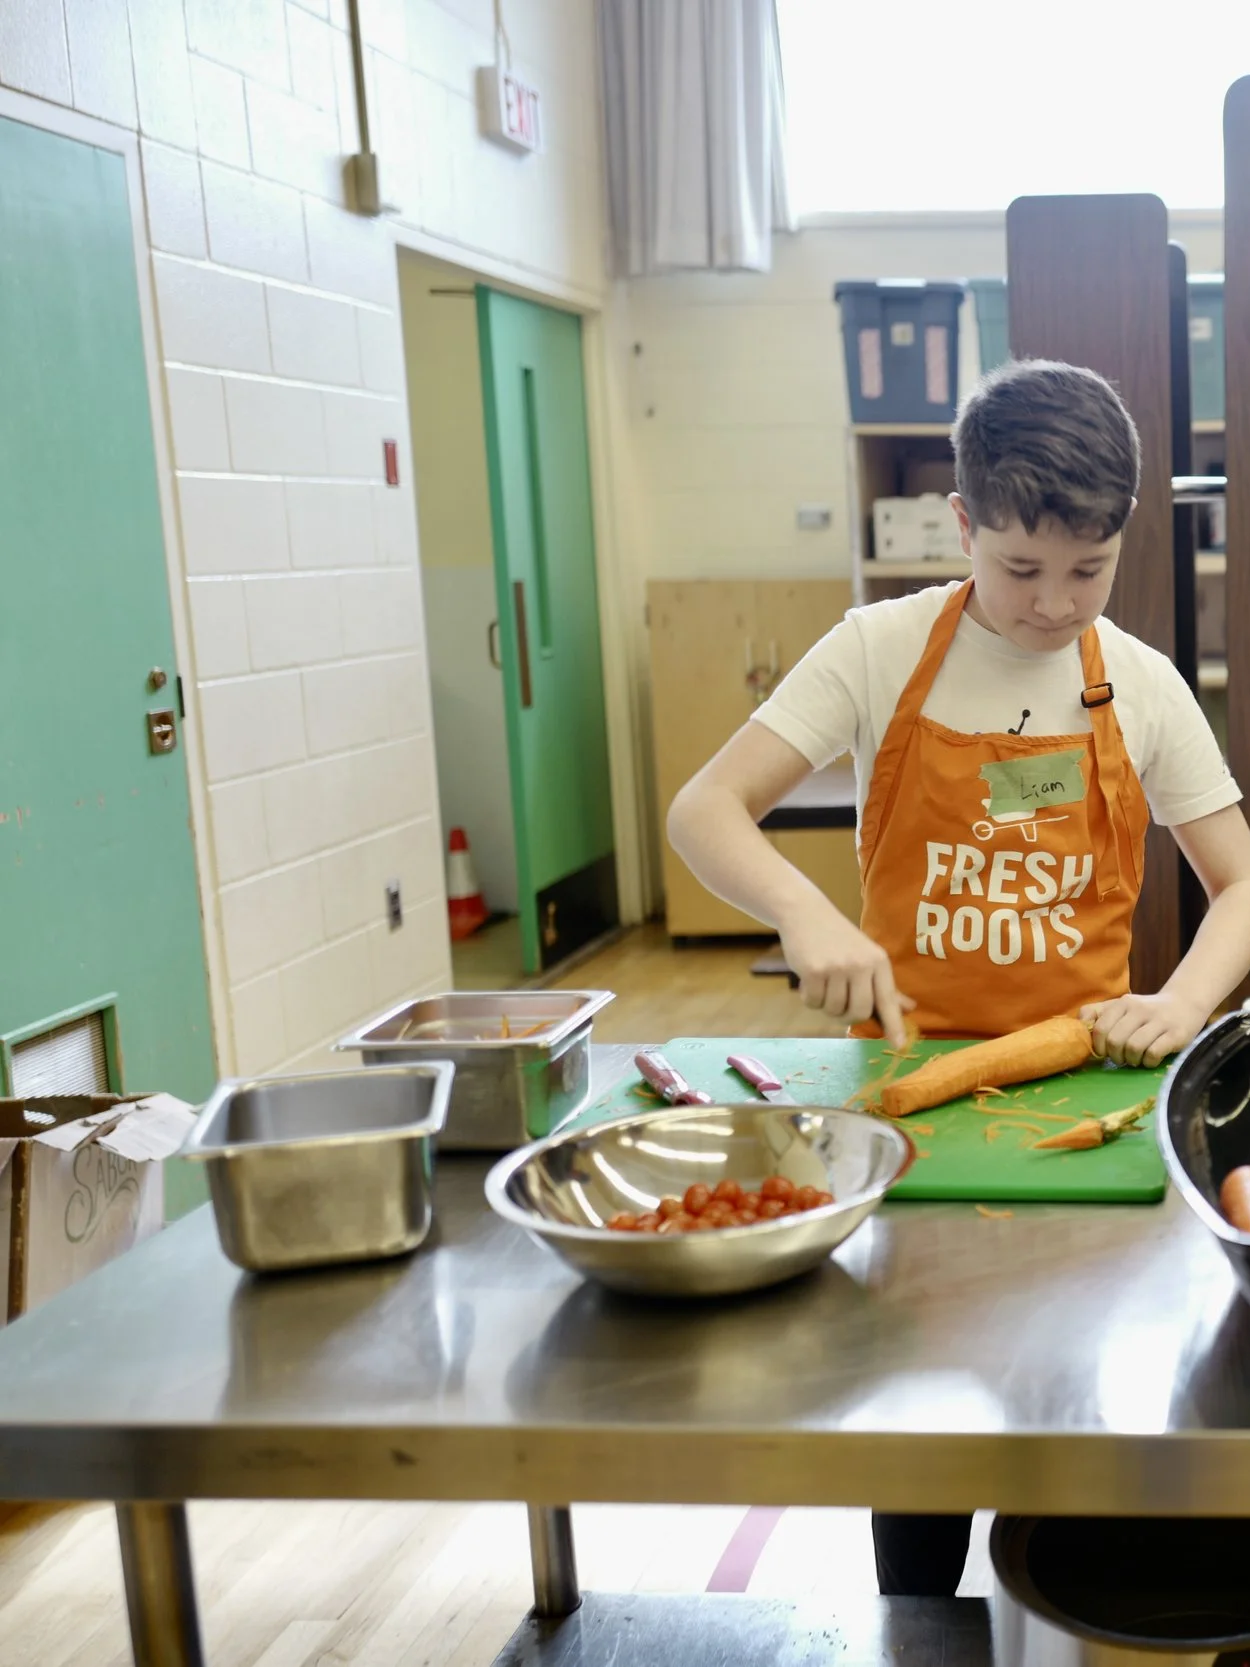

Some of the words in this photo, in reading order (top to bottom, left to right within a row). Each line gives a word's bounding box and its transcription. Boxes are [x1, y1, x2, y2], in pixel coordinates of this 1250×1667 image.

[503, 77, 540, 148] EXIT
[1021, 776, 1065, 801] Liam
[921, 841, 1093, 905] FRESH
[916, 900, 1084, 965] ROOTS
